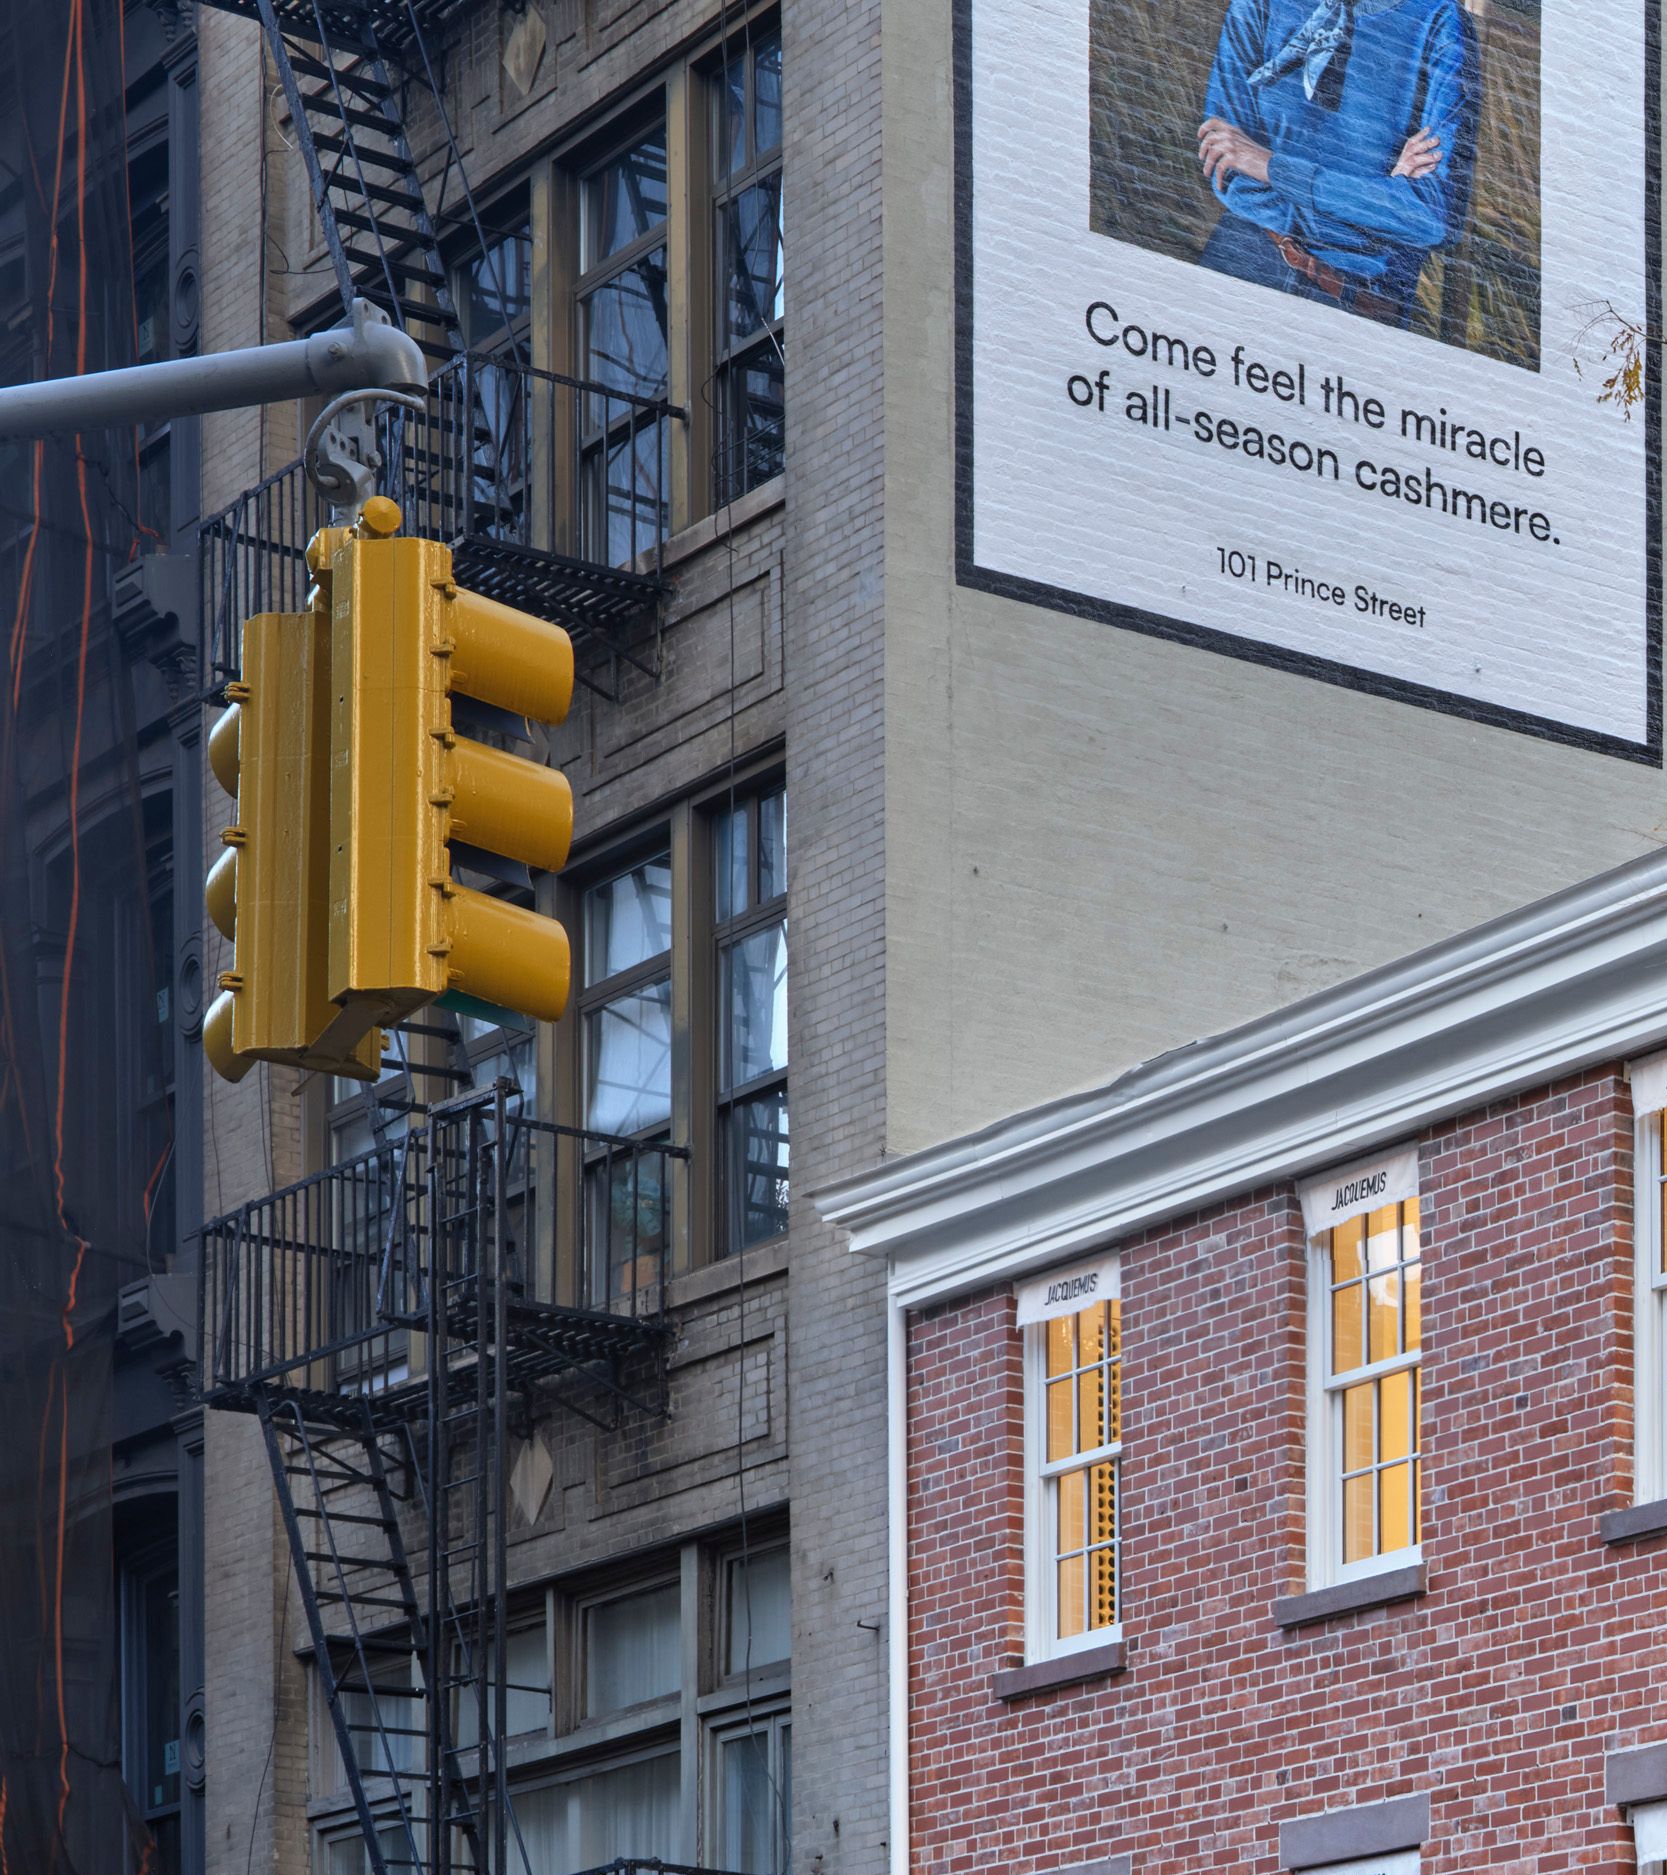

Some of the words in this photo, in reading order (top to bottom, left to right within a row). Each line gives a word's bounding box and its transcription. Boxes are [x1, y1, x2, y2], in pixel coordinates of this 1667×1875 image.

[1086, 301, 1217, 377] Come
[1231, 346, 1305, 405] feel
[1320, 376, 1386, 429] the
[1401, 408, 1545, 477] miracle
[1067, 370, 1110, 412] of
[1125, 385, 1339, 480] all-season
[1355, 460, 1560, 545] cashmere.
[1217, 547, 1256, 582] 101
[1267, 560, 1346, 606] Prince
[1354, 585, 1426, 628] Street
[1331, 1171, 1387, 1211] JACQUEMUS
[1044, 1272, 1099, 1306] JACQUEMUS
